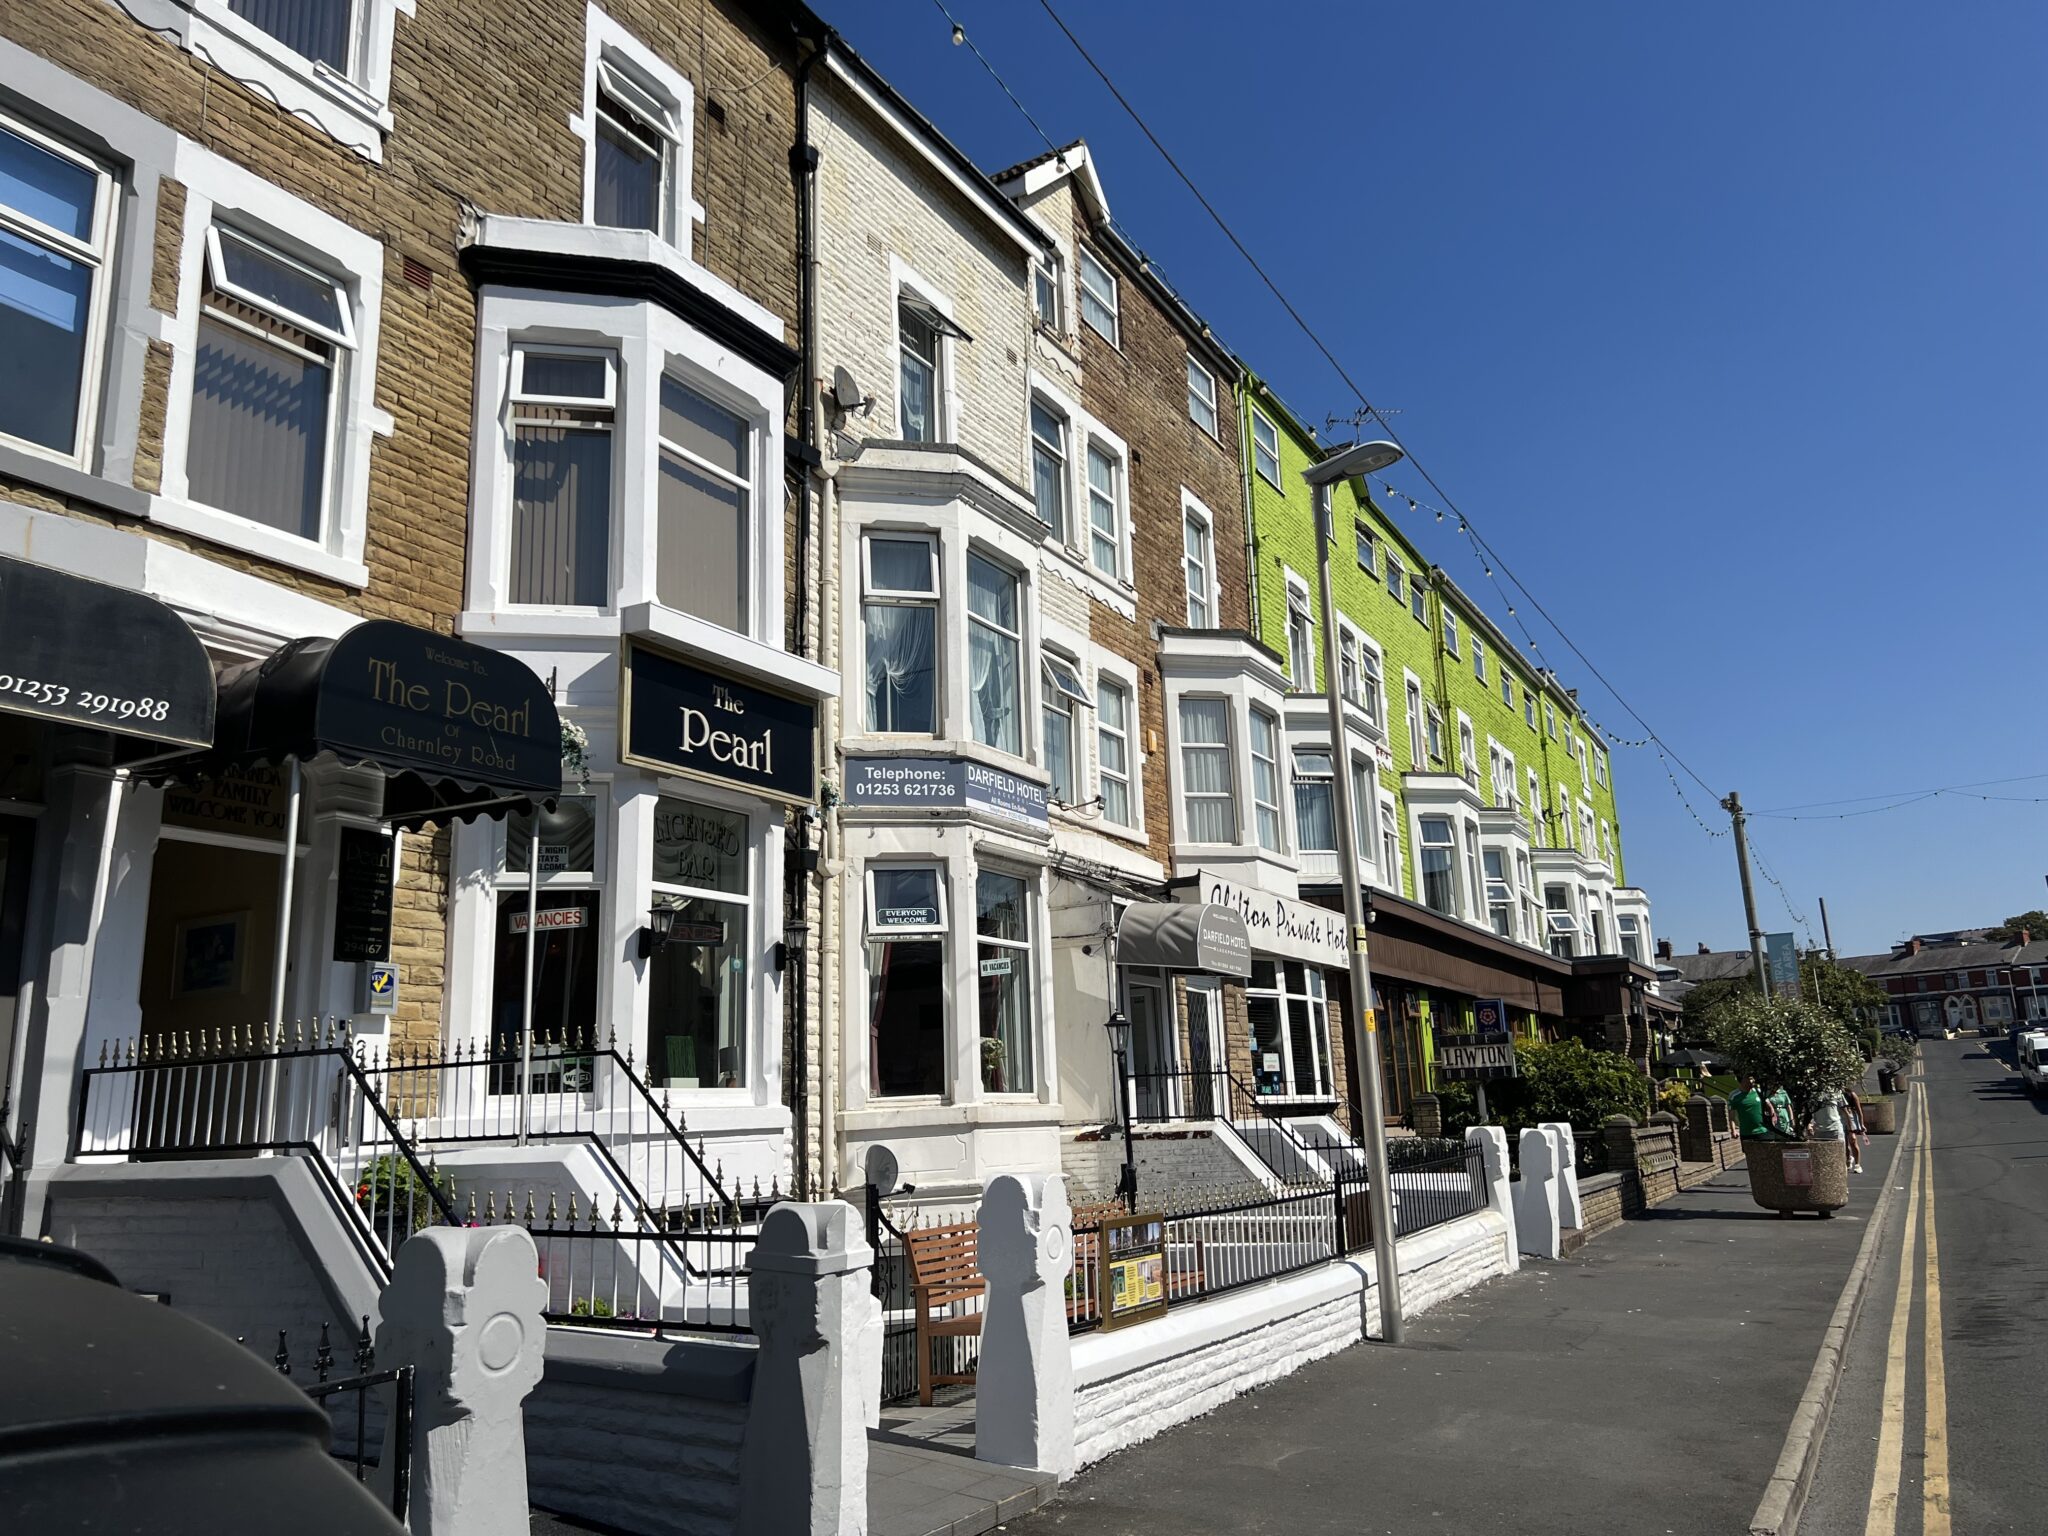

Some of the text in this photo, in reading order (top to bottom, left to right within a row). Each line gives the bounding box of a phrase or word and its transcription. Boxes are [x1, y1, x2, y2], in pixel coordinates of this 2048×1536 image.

[0, 674, 170, 721] 01253 291988
[368, 656, 530, 738] The Pearl
[712, 684, 744, 715] The
[381, 726, 516, 771] Charnley Road
[678, 706, 773, 775] Pearl
[856, 783, 956, 796] 01253 621736
[864, 767, 946, 782] Telephone:
[968, 765, 1045, 804] DARFIELD HOTEL
[677, 851, 715, 882] BAR
[514, 911, 583, 929] VAANCIES
[886, 909, 928, 917] EVERYONE
[1276, 899, 1321, 944] Private
[1326, 916, 1349, 951] Hot
[1203, 928, 1248, 950] DARFIELD HOTEL
[1444, 1046, 1508, 1067] LAWTON
